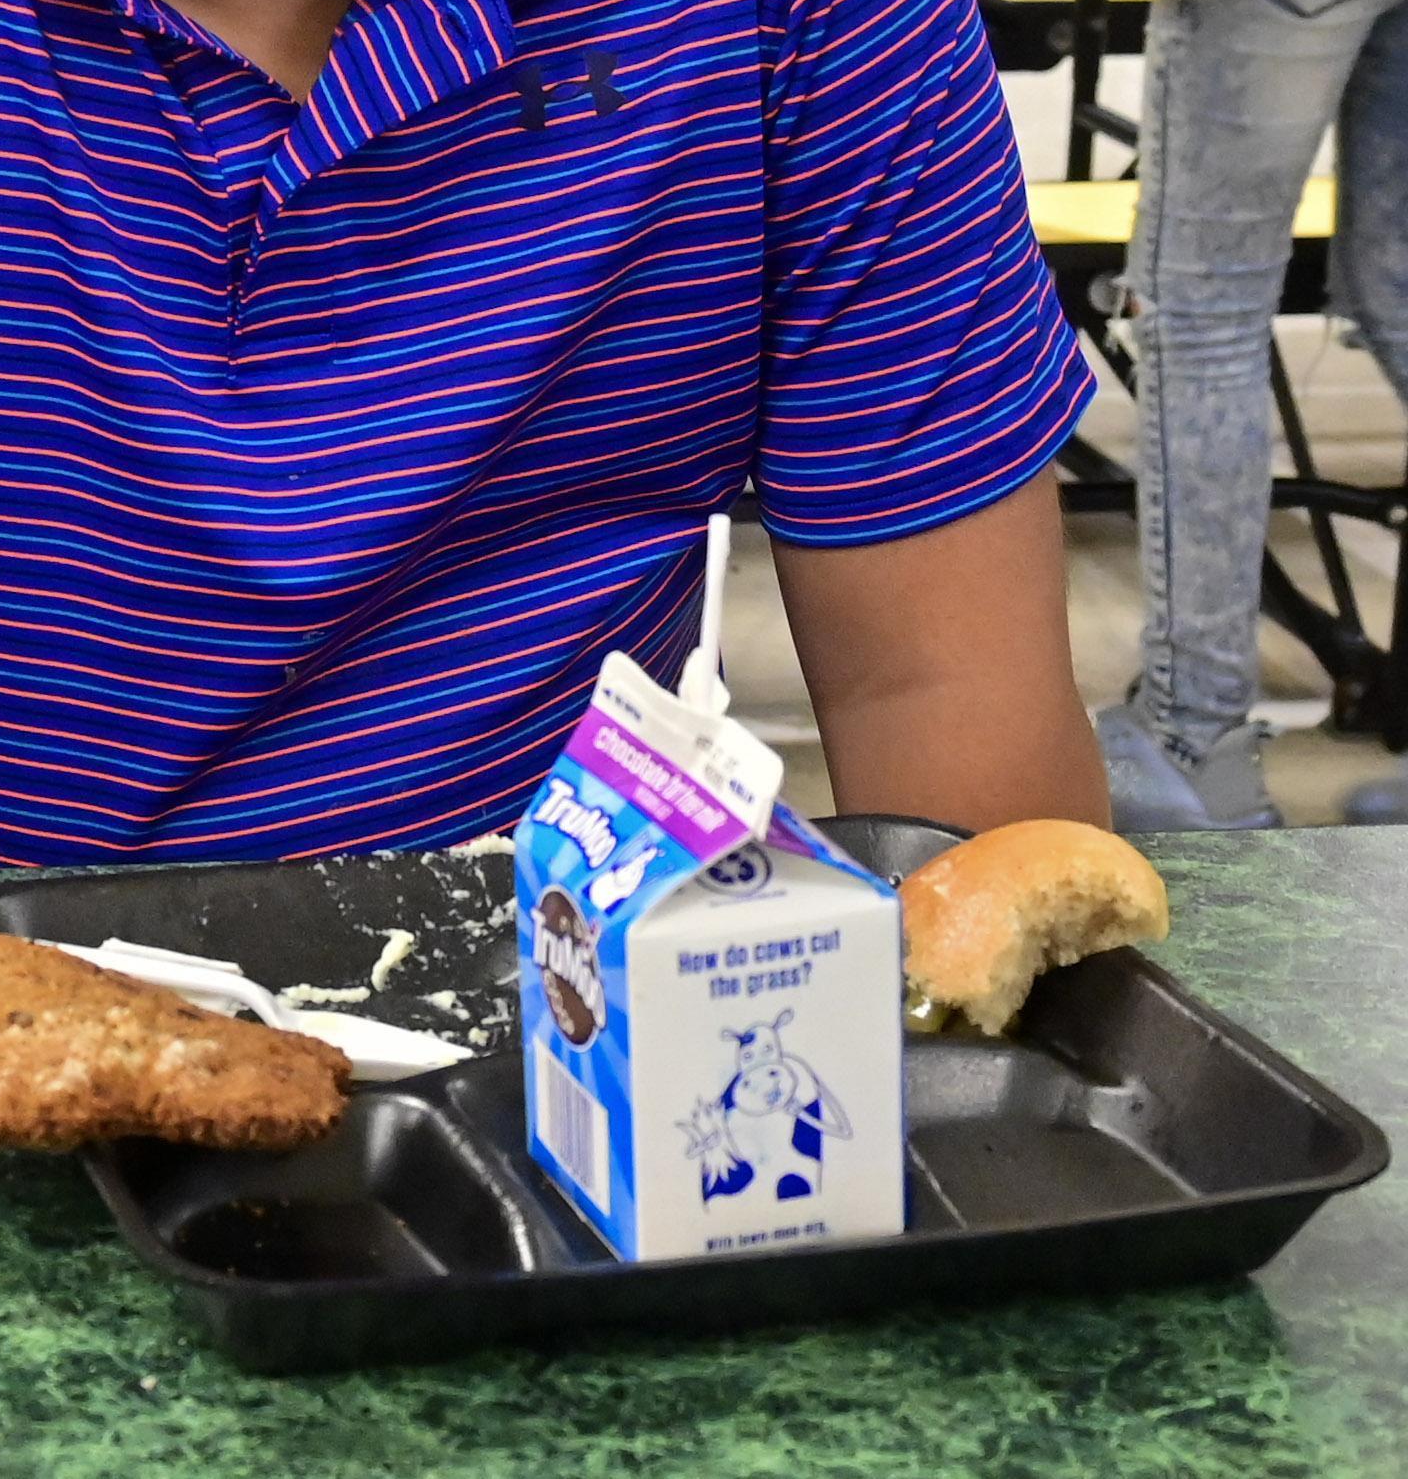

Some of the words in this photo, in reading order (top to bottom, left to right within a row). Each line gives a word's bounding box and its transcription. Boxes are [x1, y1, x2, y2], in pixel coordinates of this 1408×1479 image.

[678, 951, 719, 974] How
[725, 944, 748, 968] do
[754, 936, 805, 963] cows
[811, 929, 840, 954] cut
[710, 976, 741, 999] the
[747, 961, 813, 998] grass?
